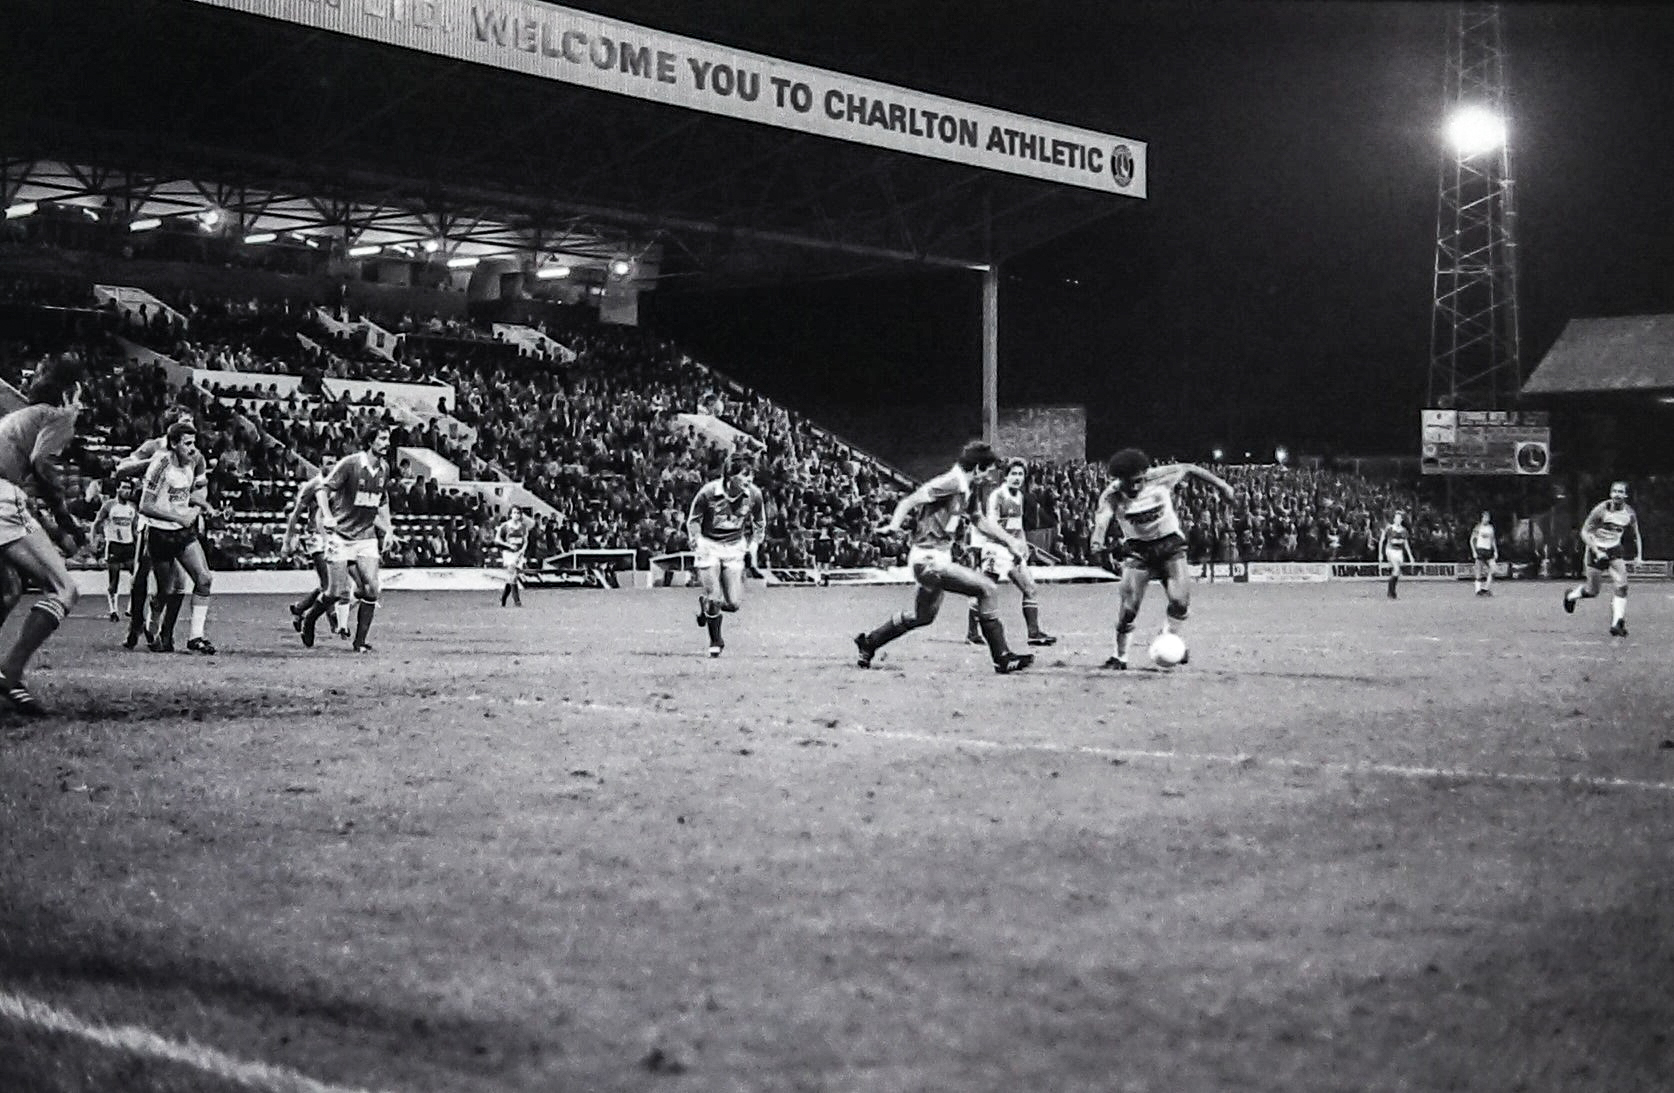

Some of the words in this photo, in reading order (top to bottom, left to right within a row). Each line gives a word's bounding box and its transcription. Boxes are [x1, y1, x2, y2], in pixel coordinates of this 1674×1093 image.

[472, 7, 677, 84] WELCOME
[687, 57, 760, 101] YOU
[770, 76, 813, 113] TO
[824, 89, 978, 148] CHARLTON
[986, 126, 1104, 173] ATHLETIC
